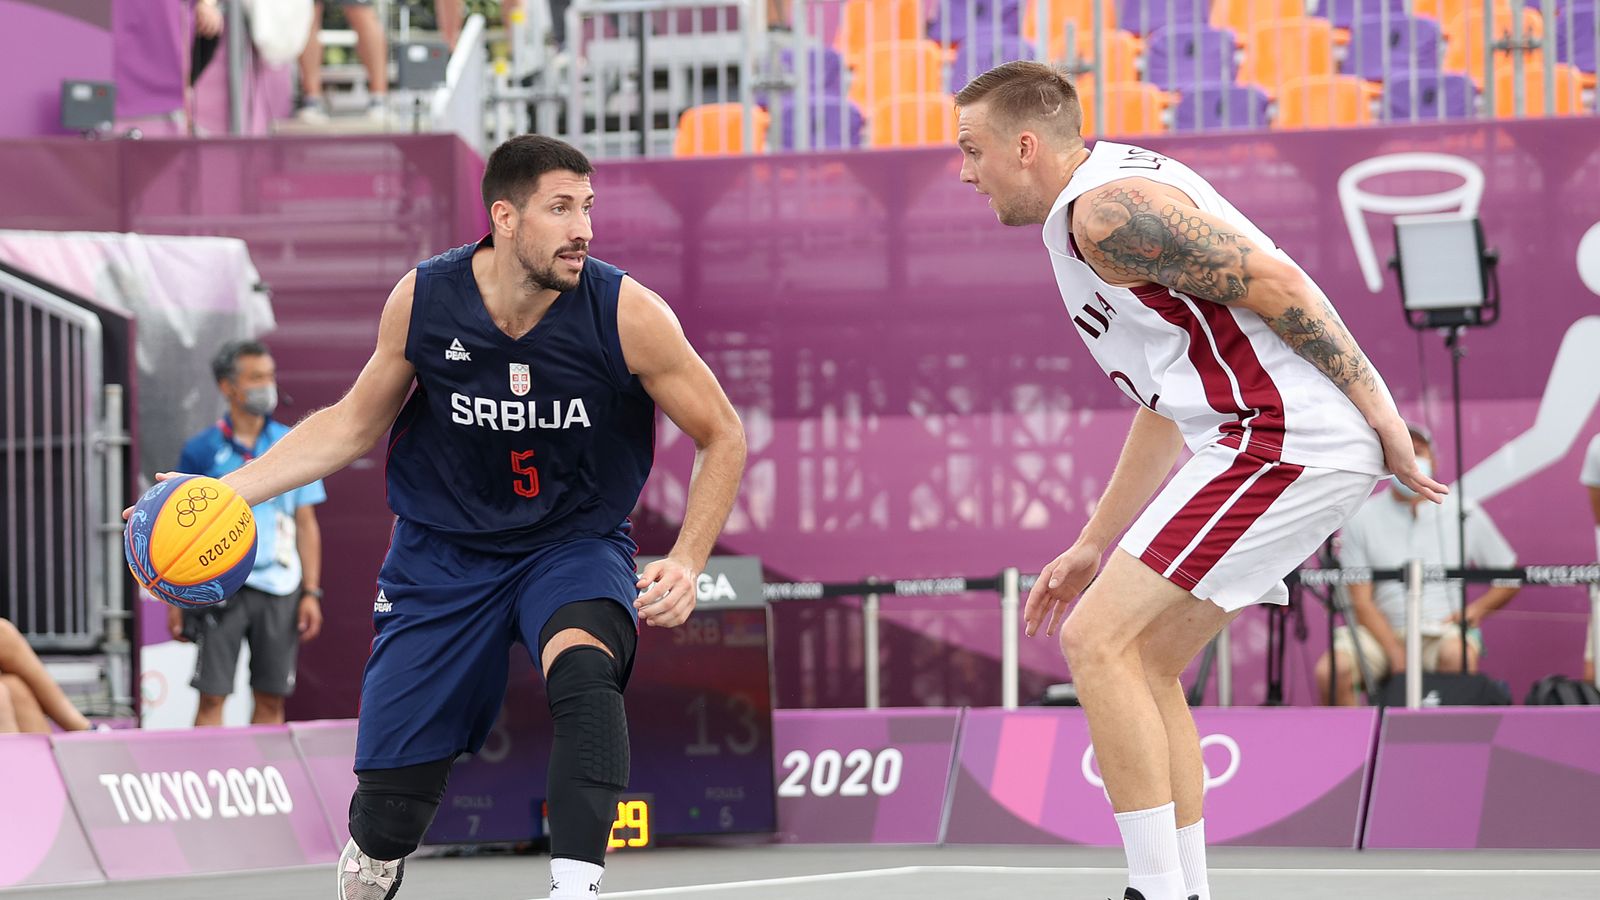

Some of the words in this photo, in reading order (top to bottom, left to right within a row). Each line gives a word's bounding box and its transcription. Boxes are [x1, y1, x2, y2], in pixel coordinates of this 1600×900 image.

[1119, 149, 1168, 170] LAS
[1073, 291, 1118, 339] IJA
[445, 349, 471, 361] PEAK
[451, 392, 591, 432] SRBIJA
[510, 449, 540, 498] 5
[229, 508, 252, 542] TOKYO
[198, 537, 231, 567] 2020
[696, 572, 738, 602] GA
[761, 582, 792, 600] OKYO
[374, 602, 393, 613] PEAK
[684, 691, 760, 757] 13
[777, 747, 904, 798] 2020
[99, 769, 214, 824] TOKYO
[207, 765, 294, 819] 2020
[608, 800, 649, 848] 29
